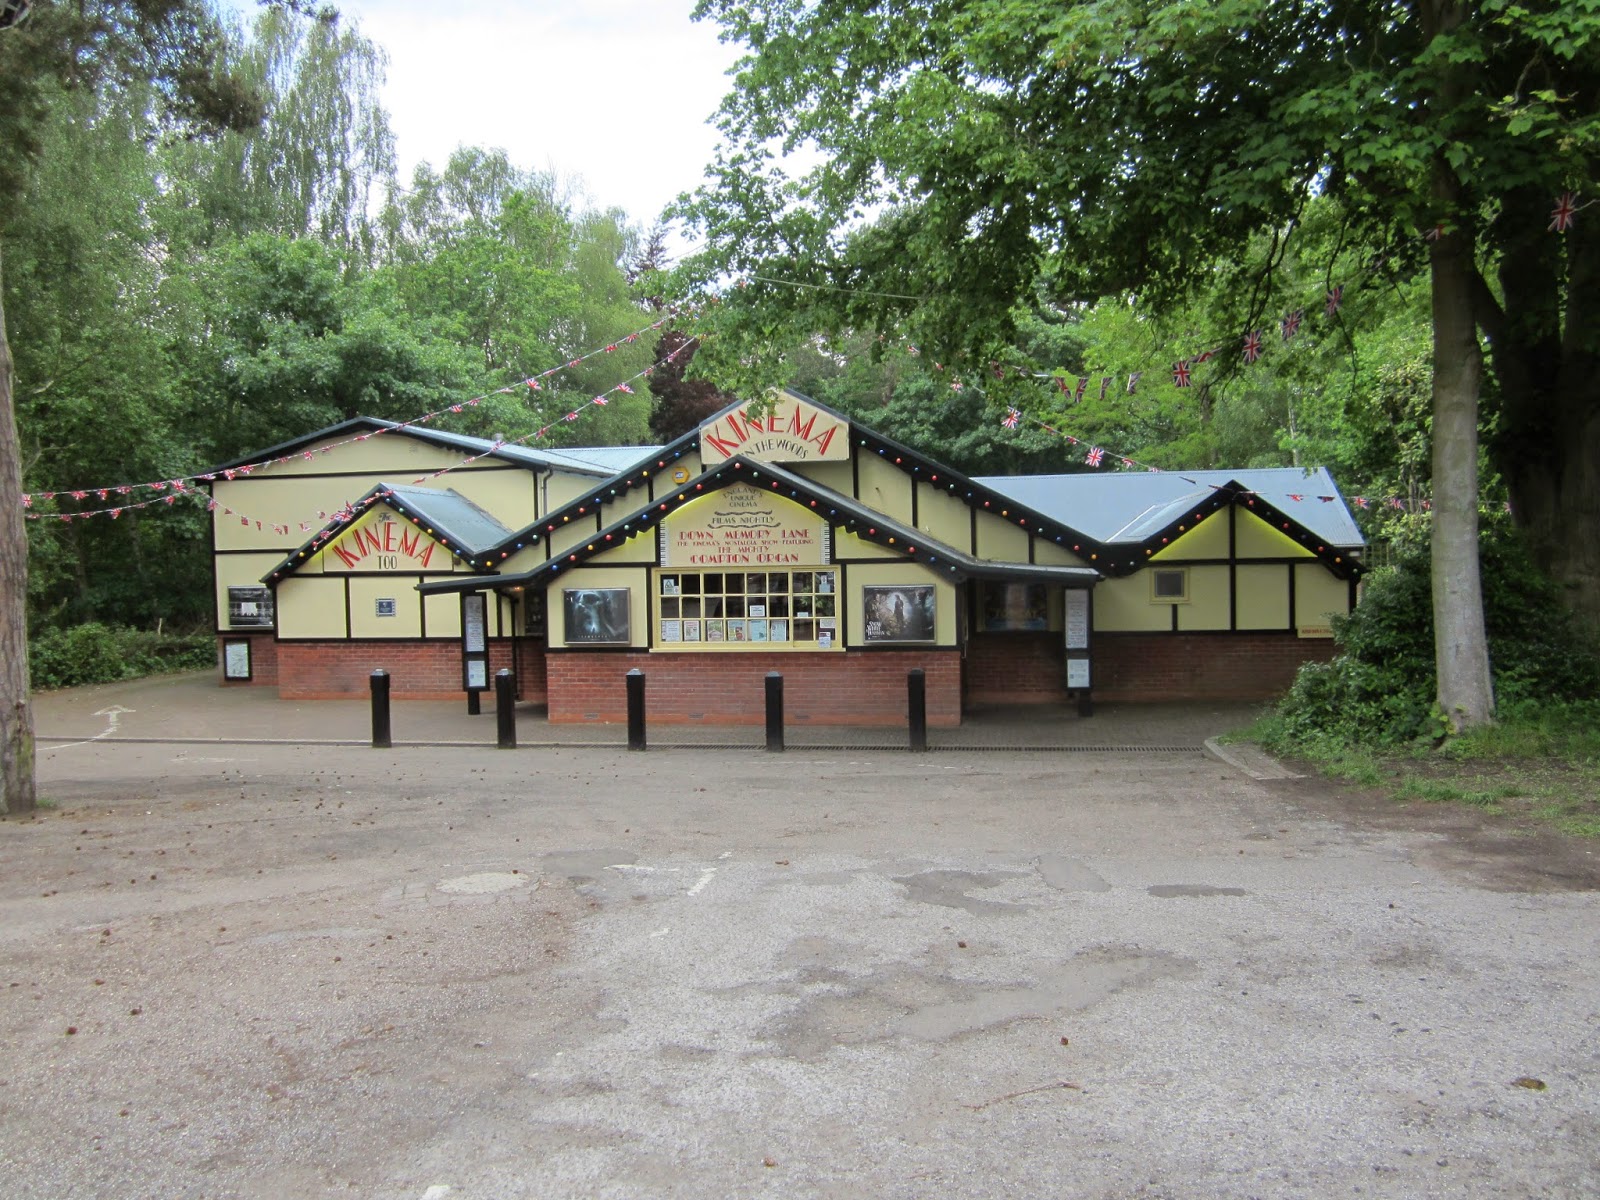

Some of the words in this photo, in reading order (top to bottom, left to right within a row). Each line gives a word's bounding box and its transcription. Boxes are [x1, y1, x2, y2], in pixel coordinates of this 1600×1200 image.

[705, 400, 838, 459] KINEMA
[755, 439, 775, 453] THE
[776, 438, 809, 459] WOODS
[378, 512, 393, 523] The
[740, 516, 775, 524] NIGHTLY
[679, 531, 714, 540] DOWN
[724, 530, 771, 539] MEMORY
[781, 529, 810, 538] LANE
[332, 522, 436, 569] KINEMA
[377, 555, 398, 570] TOO
[690, 554, 750, 564] COMPTON
[756, 553, 799, 563] ORGAN
